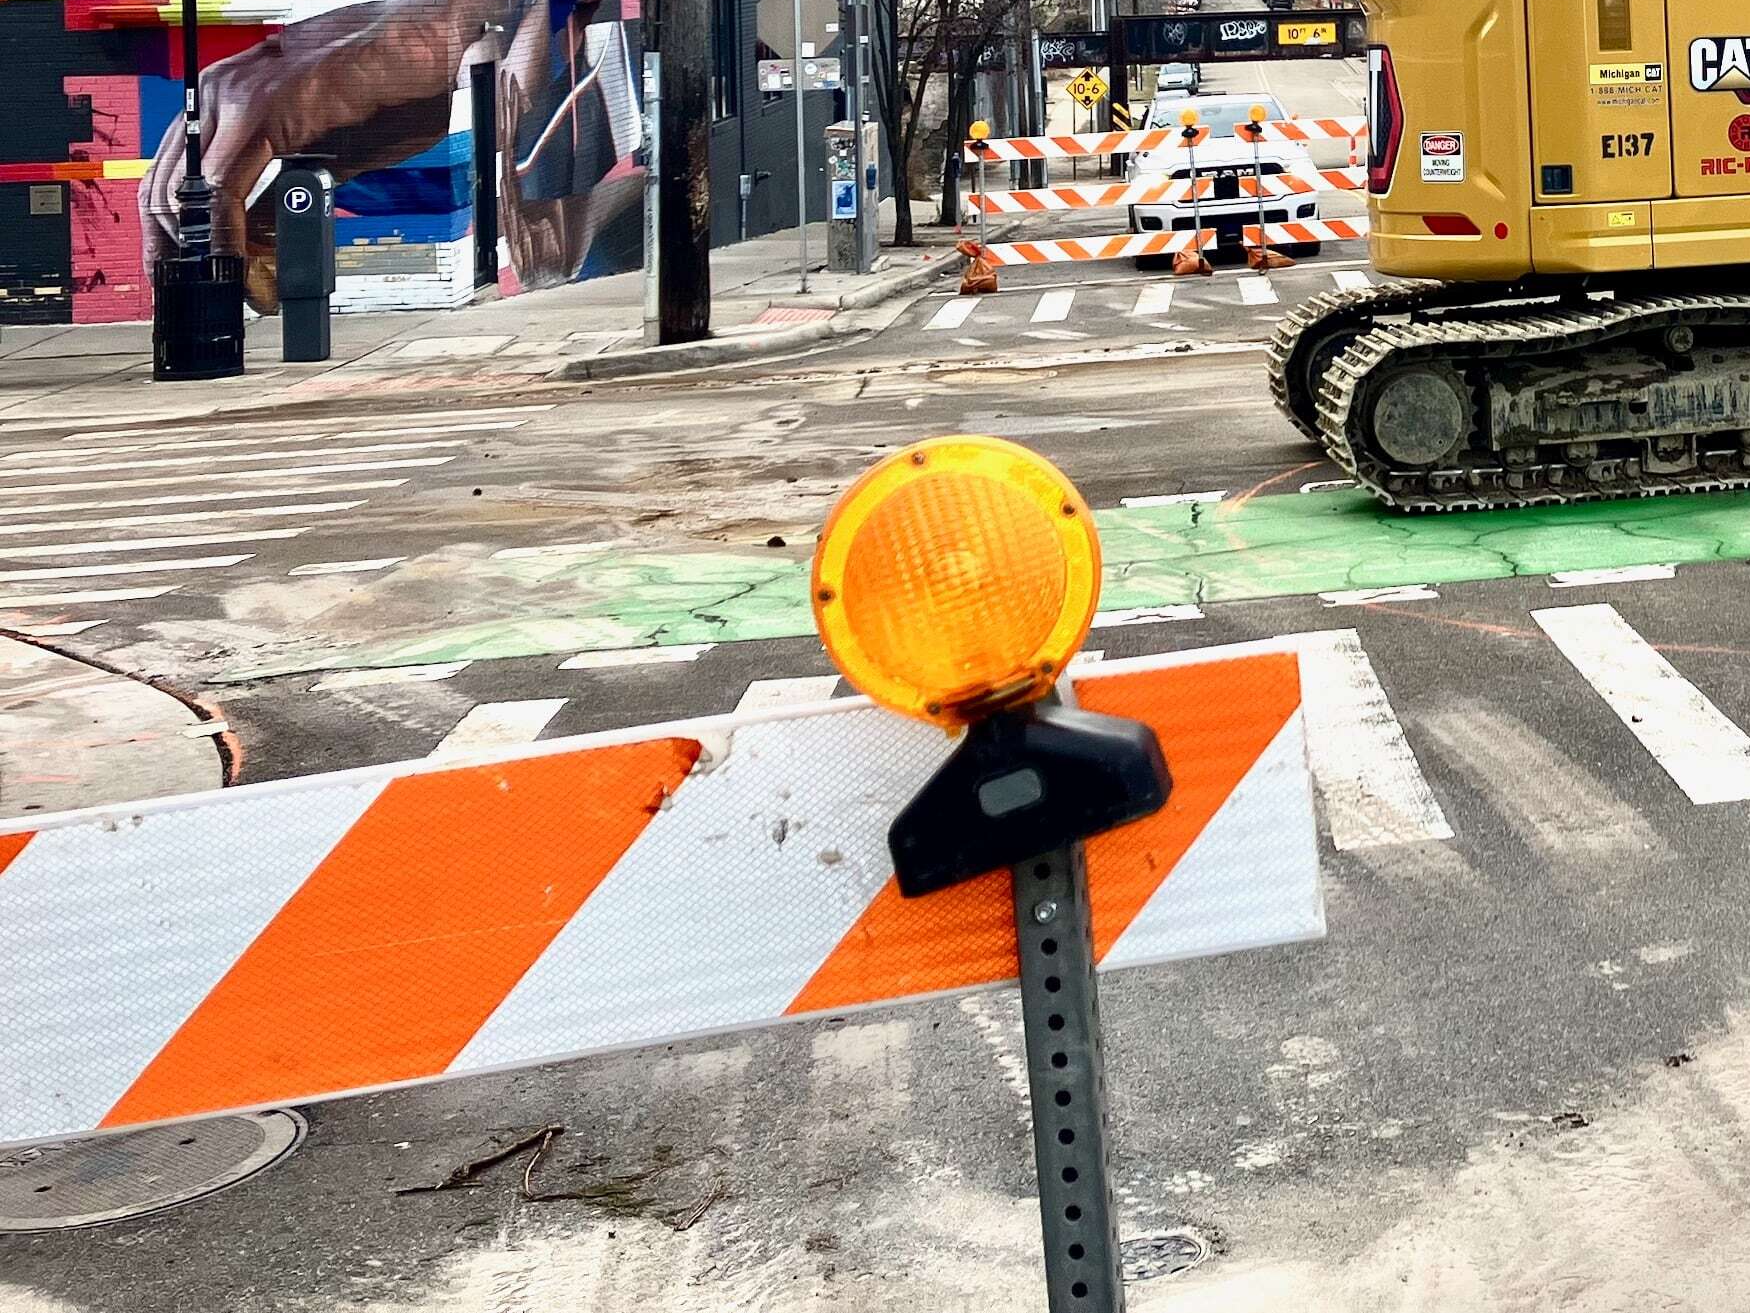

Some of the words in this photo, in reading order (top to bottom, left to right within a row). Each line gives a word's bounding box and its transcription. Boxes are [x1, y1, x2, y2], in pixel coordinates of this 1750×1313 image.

[1599, 69, 1640, 80] Michigan
[1646, 68, 1661, 78] CAT
[1073, 83, 1100, 95] 10-6
[1424, 140, 1456, 151] DANGER
[1601, 132, 1655, 159] E137
